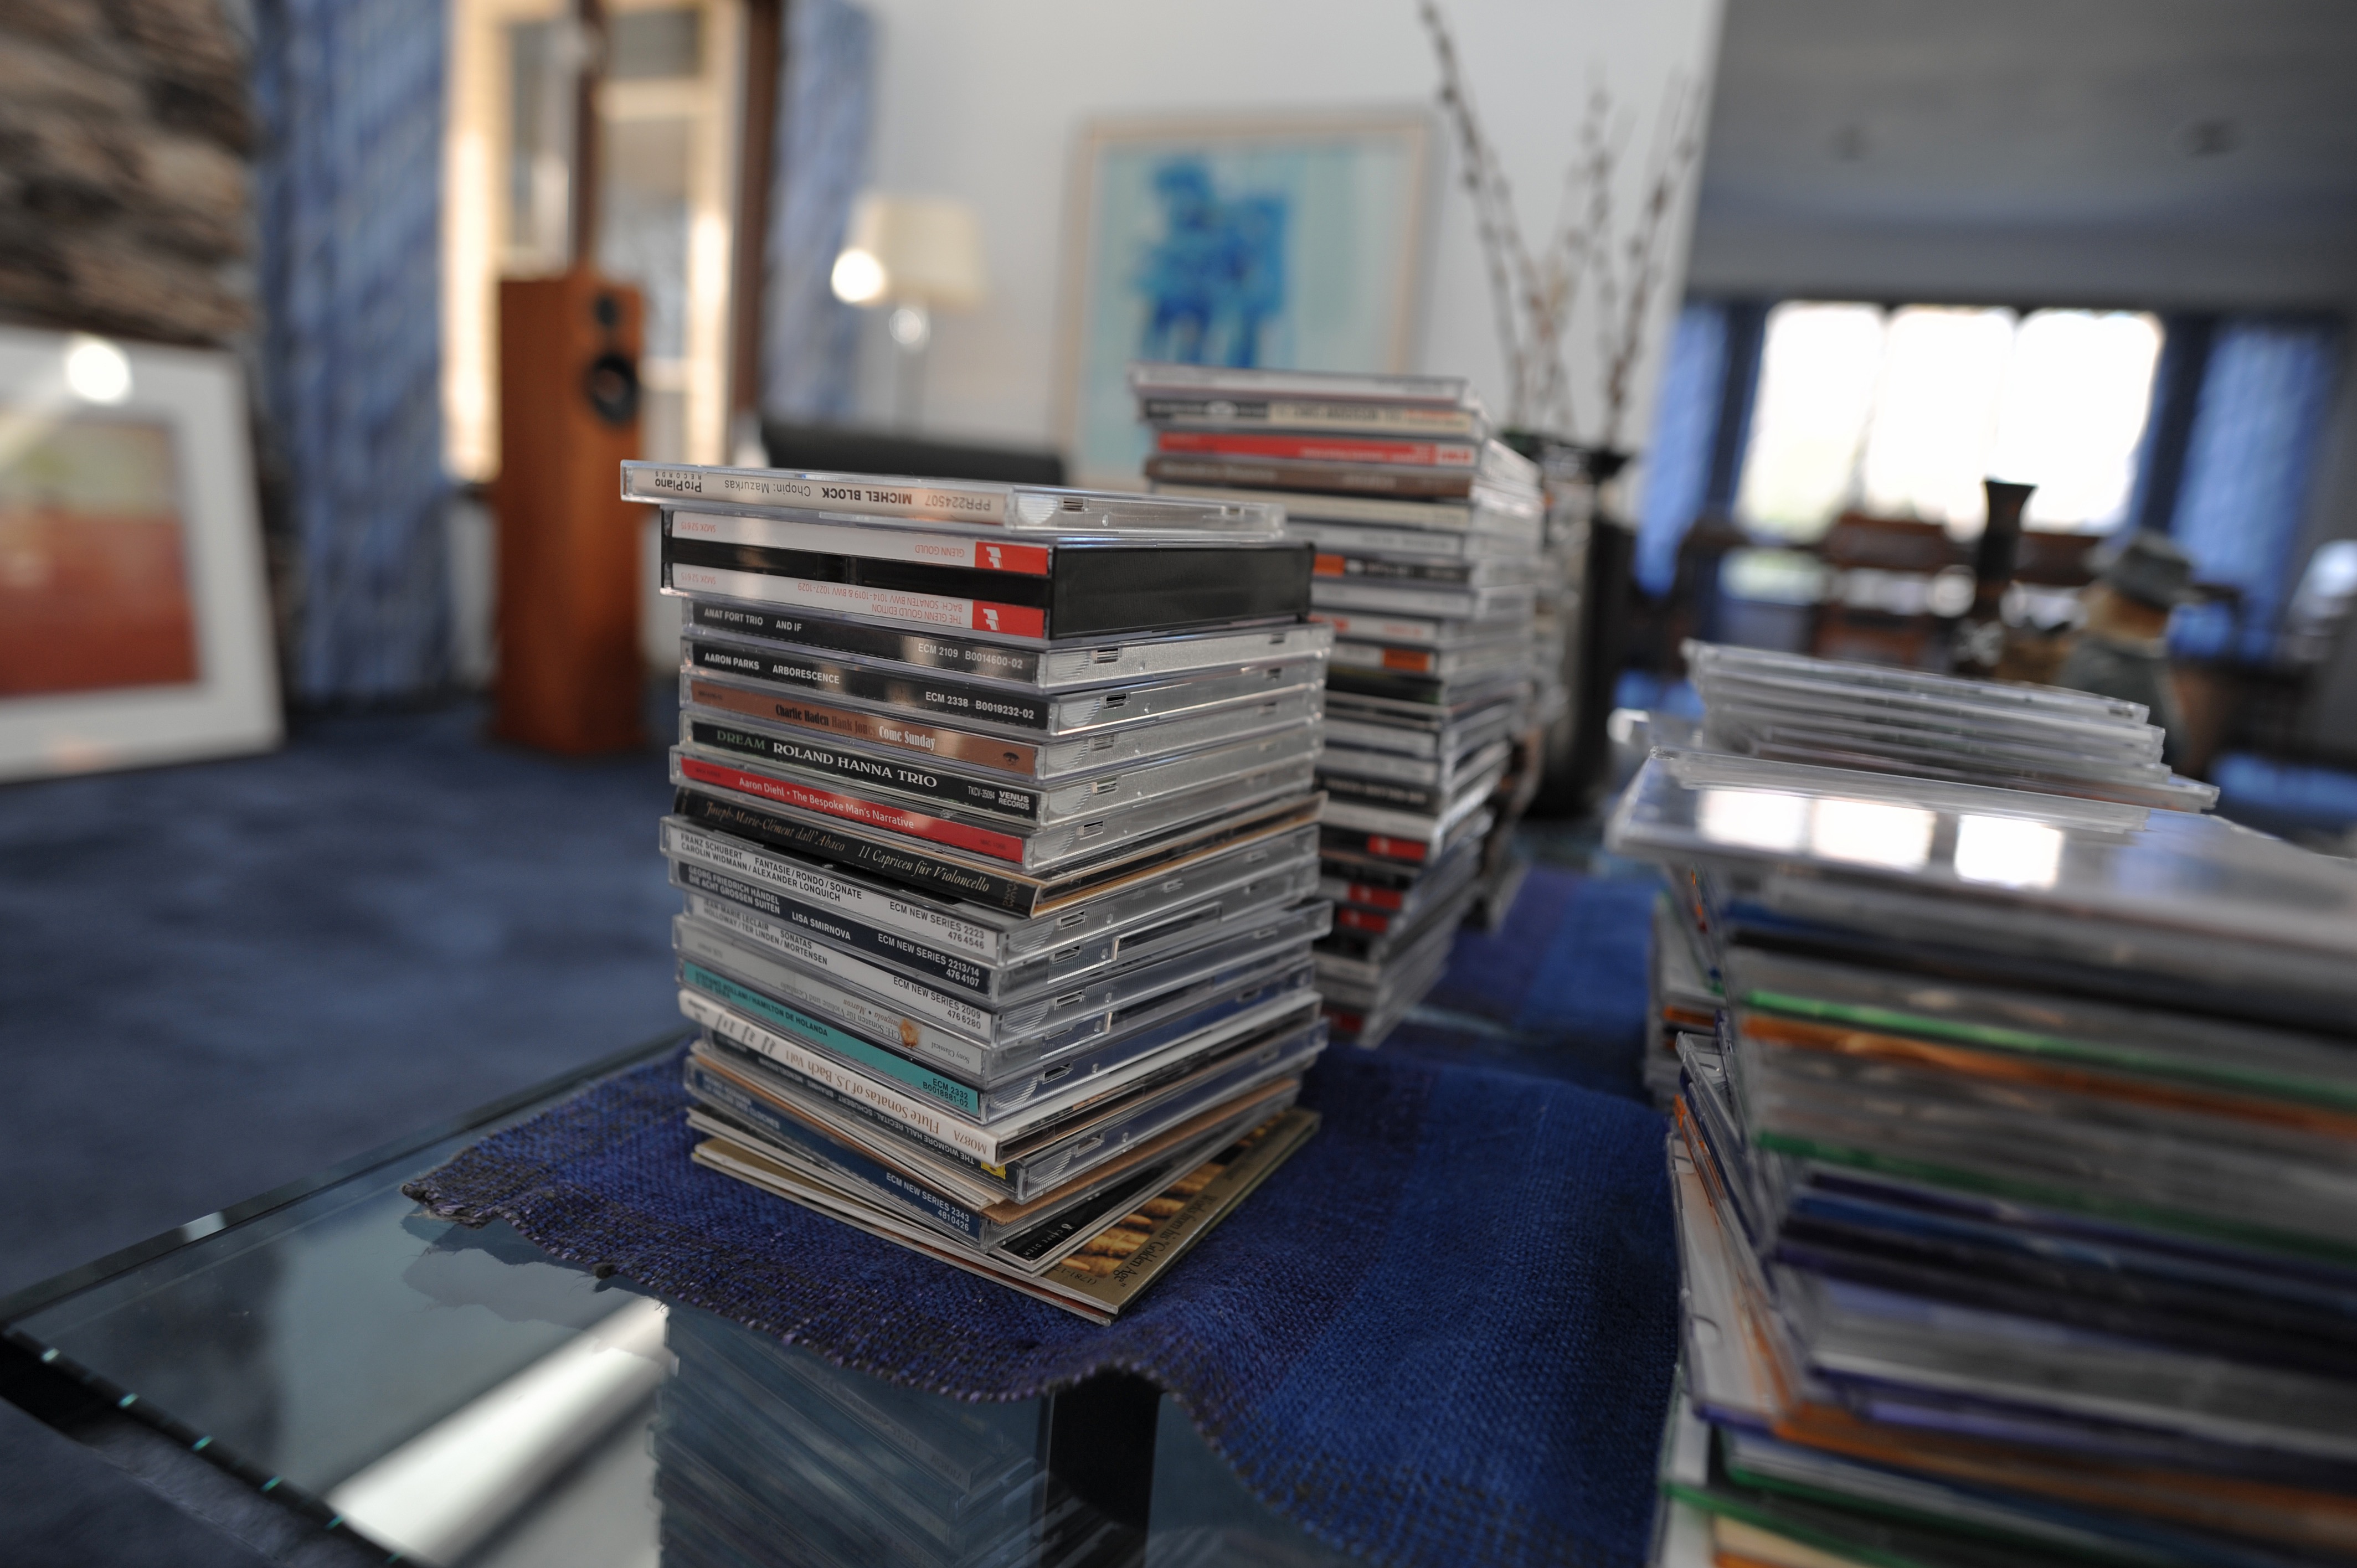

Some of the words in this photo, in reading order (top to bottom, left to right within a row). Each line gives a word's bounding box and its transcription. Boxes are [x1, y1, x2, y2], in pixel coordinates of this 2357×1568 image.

[655, 472, 702, 480] RECORDS
[725, 480, 769, 493] Mazurkas
[774, 482, 810, 496] Chopin:
[821, 487, 861, 501] BLOCK
[866, 491, 912, 504] MICHEL
[925, 494, 991, 510] PPR224507
[915, 544, 939, 555] GOULD
[942, 547, 965, 558] GLENN
[832, 587, 847, 597] BWV
[848, 589, 853, 598] &
[890, 595, 905, 605] BWV
[872, 604, 897, 615] EDITION
[907, 597, 939, 610] SONATEN
[943, 602, 963, 612] BACH:
[704, 608, 723, 618] ANAT
[724, 611, 744, 622] FORT
[745, 614, 763, 626] TRIO
[776, 620, 792, 631] AND
[794, 623, 802, 632] IF
[899, 607, 923, 618] GOULD
[924, 611, 947, 622] GLENN
[949, 614, 963, 625] THE
[918, 643, 936, 654] ECM
[939, 647, 958, 658] 2109
[965, 651, 1023, 669] B0014600-02
[704, 652, 732, 665] AARON
[733, 657, 759, 670] PARKS
[773, 664, 840, 684] ARBORESCENCE
[925, 692, 944, 703] ECM
[947, 696, 969, 708] 2338
[975, 700, 1035, 719] B0019232-02
[775, 704, 802, 720] Charlie
[804, 710, 830, 726] Haden
[831, 714, 853, 731] Hank
[855, 721, 876, 737] Jones
[879, 725, 902, 742] Come
[904, 731, 935, 751] Sunday
[717, 729, 765, 750] DREAM
[773, 742, 834, 765] ROLAND
[837, 757, 893, 778] HANNA
[897, 770, 937, 787] TRIO
[739, 777, 763, 791] Aaron
[764, 782, 784, 797] Diehl
[792, 790, 807, 802] The
[809, 795, 844, 812] Bespoke
[846, 803, 870, 818] Man's
[872, 809, 914, 829] Narrative
[999, 791, 1030, 803] VENUS
[999, 798, 1030, 811] RECORDS
[681, 833, 703, 846] FRANZ
[705, 840, 742, 859] SCHUBERT
[755, 857, 790, 876] FANTASIE
[796, 871, 824, 886] RONDO
[830, 881, 862, 899] SONATE
[681, 843, 711, 859] CAROLIN
[712, 852, 747, 871] WIDMANN
[753, 866, 801, 886] ALEXANDER
[800, 881, 841, 902] LONQUICH
[872, 849, 913, 871] Capricen
[911, 860, 932, 877] für
[933, 866, 990, 892] Violoncello
[689, 875, 699, 885] DIE
[702, 879, 719, 891] ACHT
[720, 884, 753, 904] GROSSEN
[755, 897, 780, 914] SUITEN
[688, 867, 712, 881] GEORG
[713, 874, 749, 894] FRIEDRICH
[792, 911, 809, 925] LISA
[810, 917, 851, 941] SMIRNOVA
[890, 901, 907, 914] ECM
[909, 907, 928, 921] NEW
[930, 914, 961, 932] SERIES
[964, 925, 985, 939] 2223
[703, 908, 737, 927] HOLLOWAY
[742, 922, 754, 934] TER
[755, 928, 779, 945] LINDEN
[784, 941, 827, 965] MORTENSEN
[742, 912, 769, 931] LECLAIR
[780, 929, 812, 949] SONATAS
[878, 933, 895, 946] ECM
[897, 939, 914, 953] NEW
[916, 947, 946, 964] SERIES
[948, 958, 979, 977] 2213/14
[809, 994, 821, 1005] und
[843, 998, 867, 1014] Marcon
[893, 977, 909, 990] ECM
[912, 984, 929, 998] NEW
[930, 992, 960, 1010] SERIES
[961, 1005, 981, 1019] 2009
[752, 997, 784, 1017] HAMILTON
[785, 1011, 794, 1022] DE
[796, 1016, 828, 1036] HOLANDA
[858, 1015, 884, 1033] Sonaten
[931, 1041, 955, 1059] Classical
[956, 1051, 970, 1064] Sony
[807, 1061, 832, 1082] Bach
[807, 1080, 834, 1097] BRAHMS
[834, 1073, 849, 1091] J.S.
[851, 1084, 863, 1095] of
[933, 1078, 949, 1091] ECM
[950, 1086, 969, 1100] 2332
[923, 1082, 969, 1108] B0018881-02
[837, 1095, 873, 1116] SCHUBERT
[865, 1091, 908, 1118] Sonatas
[910, 1112, 940, 1134] Flute
[905, 1125, 923, 1139] HALL
[924, 1134, 959, 1156] WIGMORE
[960, 1152, 975, 1164] THE
[886, 1172, 902, 1187] ECM
[903, 1181, 920, 1196] NEW
[922, 1192, 950, 1211] SERIES
[951, 1206, 970, 1223] 2343
[1170, 1213, 1197, 1230] from
[1042, 1229, 1063, 1244] CARPE
[1160, 1229, 1181, 1240] his
[1023, 1244, 1042, 1256] DIEM
